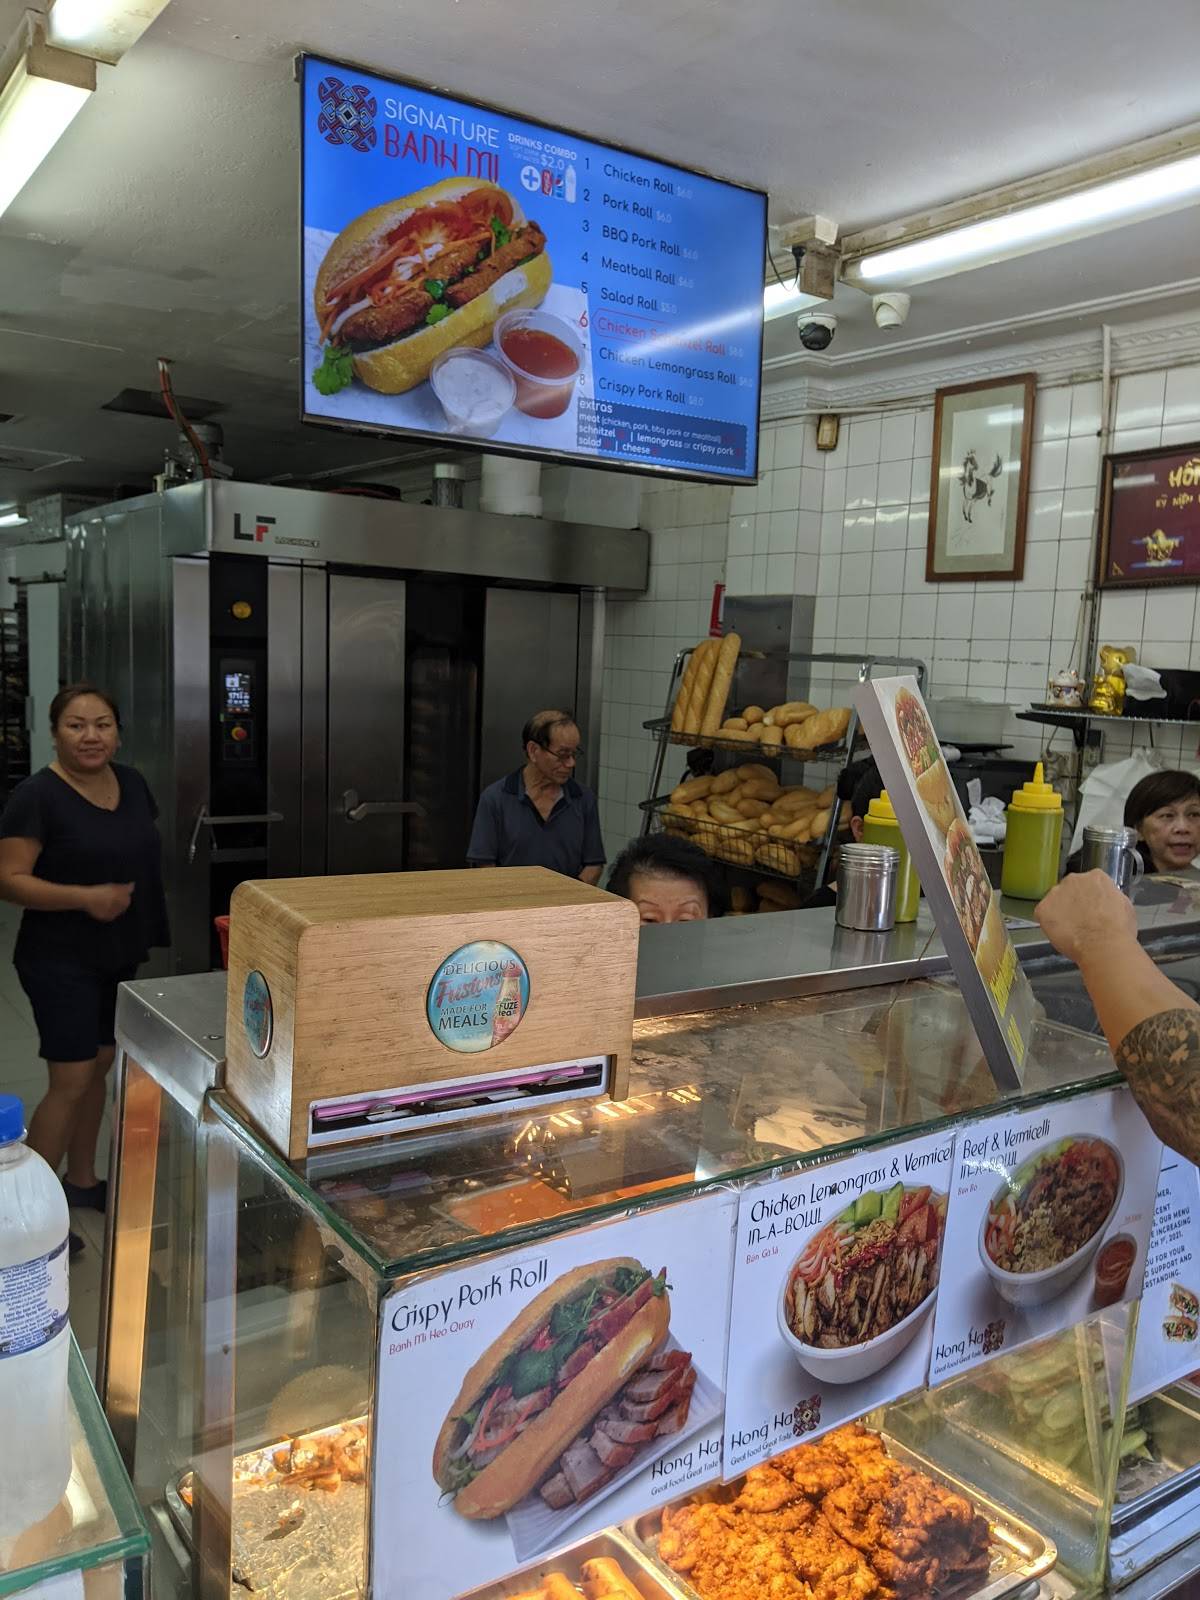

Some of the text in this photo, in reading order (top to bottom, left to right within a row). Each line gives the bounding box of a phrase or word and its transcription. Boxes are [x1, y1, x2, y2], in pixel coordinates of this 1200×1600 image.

[384, 98, 499, 148] SIGNATURE
[384, 123, 457, 172] BANH
[508, 133, 542, 150] DRINKS
[544, 144, 577, 160] COMBO
[585, 157, 590, 170] 1
[603, 163, 650, 188] Chicken
[654, 178, 674, 195] Roll
[583, 188, 590, 201] 2
[603, 194, 628, 212] Pork
[632, 202, 653, 219] Roll
[582, 220, 590, 232] 3
[602, 225, 628, 242] BBQ
[632, 233, 656, 250] Pork
[660, 240, 680, 256] Roll
[581, 252, 589, 263] 4
[601, 256, 652, 280] Meatball
[656, 270, 676, 286] Roll
[581, 282, 588, 294] 5
[601, 288, 634, 306] Salad
[638, 296, 658, 312] Roll
[579, 310, 588, 328] 6
[598, 317, 646, 338] Chicken
[706, 340, 726, 356] Roll
[600, 348, 645, 366] Chicken
[648, 357, 714, 380] Lemongrass
[718, 370, 736, 384] Roll
[579, 374, 586, 386] 8
[598, 378, 636, 398] Crispy
[638, 384, 662, 400] Pork
[666, 390, 686, 405] Roll
[579, 400, 613, 414] extras
[579, 413, 600, 424] meat
[666, 428, 682, 436] pork
[578, 437, 601, 447] salad
[622, 443, 650, 454] cheese
[579, 425, 616, 438] schnitzel
[637, 432, 682, 449] lemongrass
[717, 446, 734, 456] pork
[445, 960, 516, 976] DELICIOUS
[441, 1004, 487, 1016] MADE FOR
[499, 1001, 518, 1010] FUZE
[438, 1012, 488, 1031] MEALS
[962, 1118, 1050, 1159] Beef & Vermicelli
[750, 1192, 806, 1223] Chicken
[810, 1168, 886, 1204] Lemongrass
[891, 1158, 902, 1176] &
[748, 1207, 822, 1247] IN-A-BOWL
[1156, 1217, 1191, 1236] INCREASING
[1160, 1214, 1172, 1225] OUR
[1174, 1206, 1190, 1219] MENU
[1150, 1257, 1178, 1276] SUPPORT
[1180, 1252, 1192, 1265] AND
[1155, 1252, 1168, 1263] FOR
[1169, 1245, 1186, 1257] YOUR
[1143, 1268, 1182, 1290] RSTANDING.
[392, 1259, 548, 1332] Crispy Pork Roll
[430, 1328, 448, 1341] Heo
[450, 1318, 476, 1334] Quay
[936, 1326, 984, 1360] Hong Ha
[731, 1412, 793, 1450] Hong Ha
[652, 1440, 719, 1480] Hong Ha
[730, 1455, 747, 1466] Great
[762, 1438, 778, 1450] Great
[651, 1483, 668, 1496] Great
[686, 1466, 703, 1480] Great
